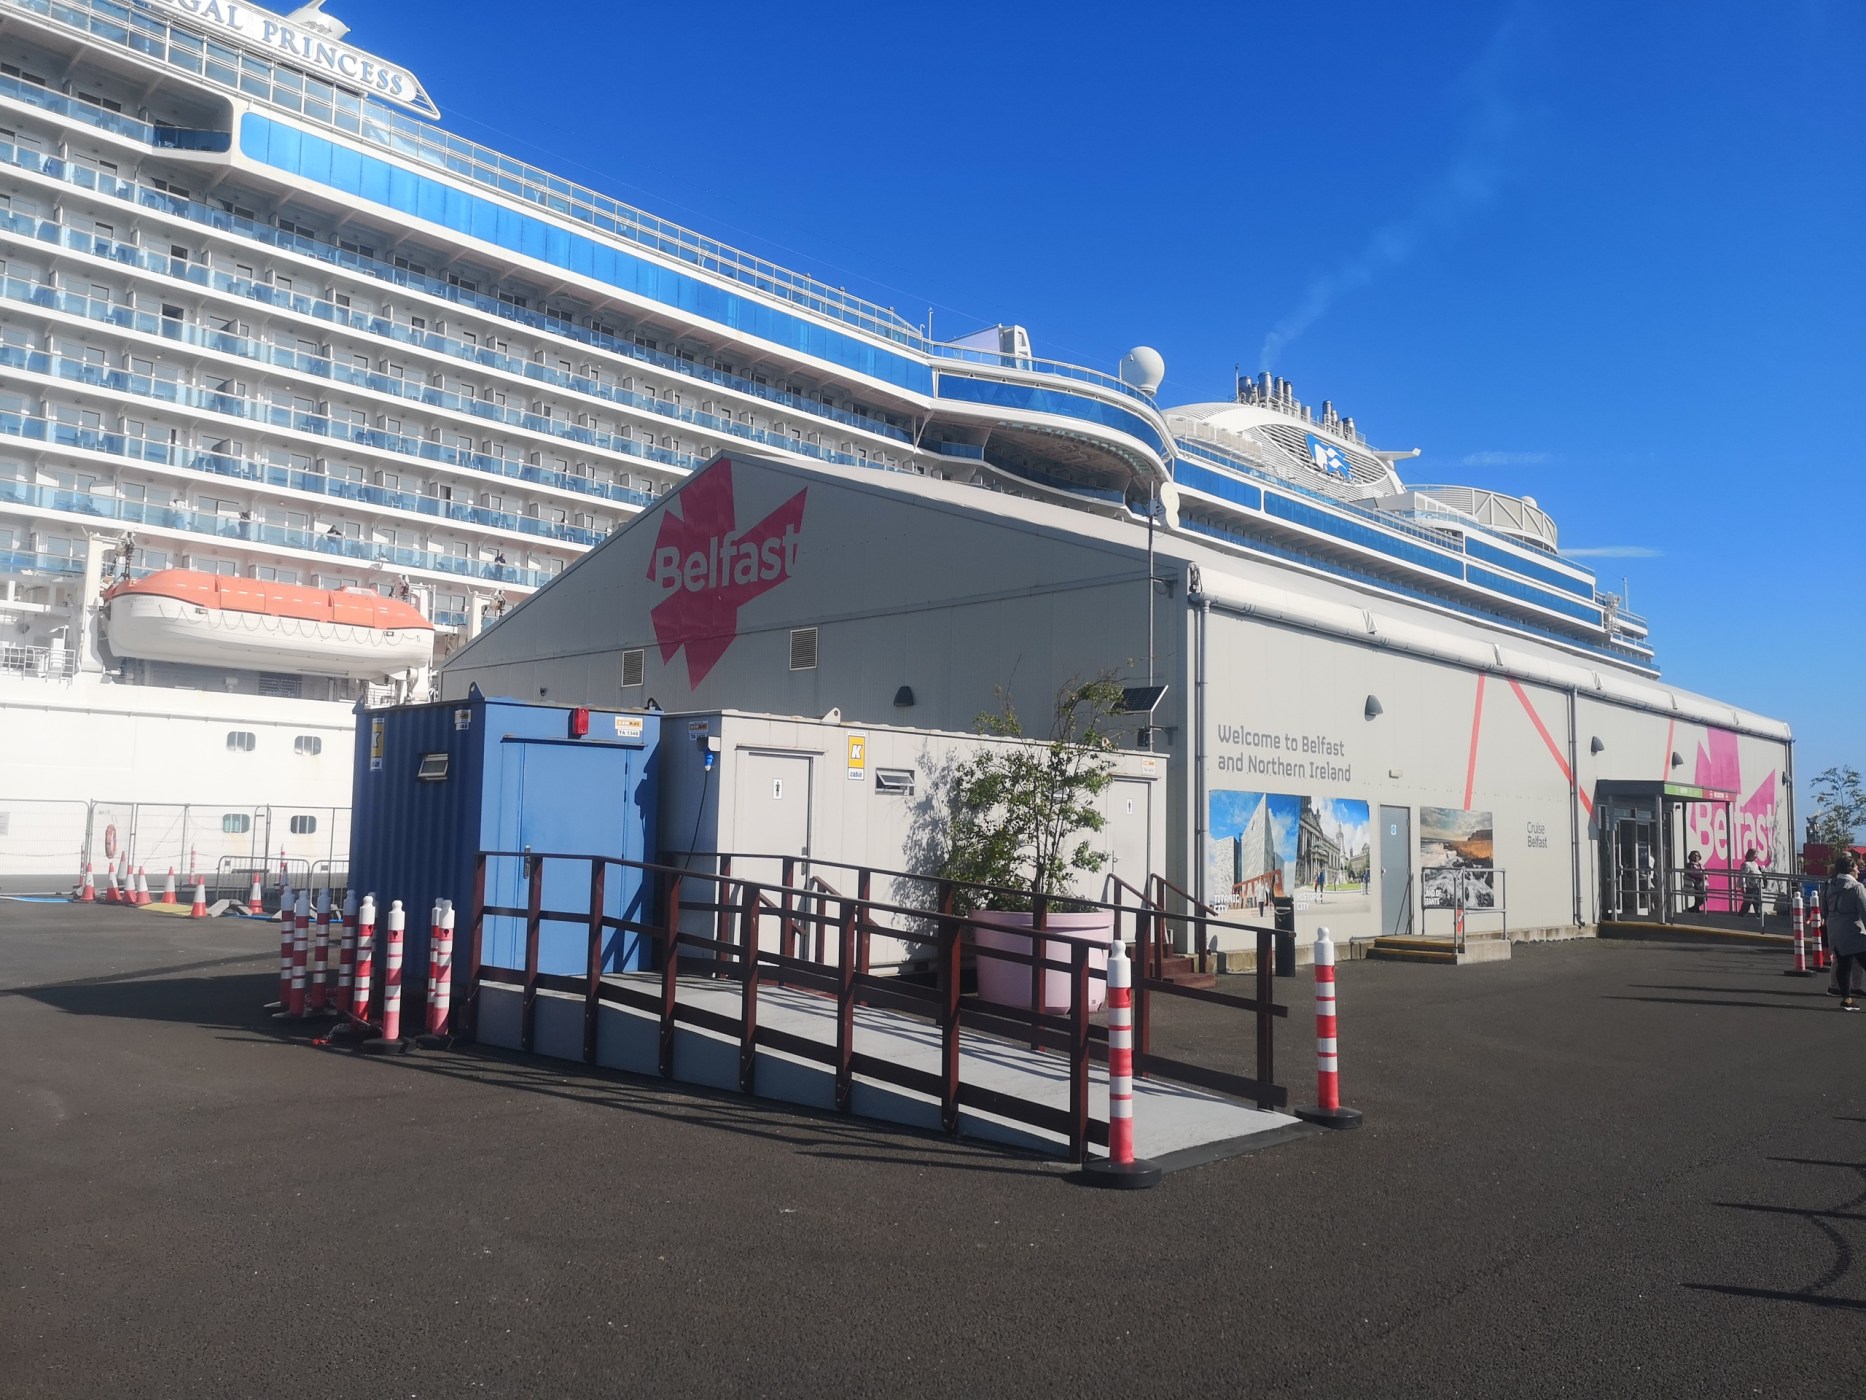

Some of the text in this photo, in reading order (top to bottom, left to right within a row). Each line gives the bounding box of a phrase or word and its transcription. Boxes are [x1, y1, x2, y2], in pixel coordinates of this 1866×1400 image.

[170, 0, 404, 96] GAL PRINCESS
[655, 523, 801, 595] Belfast
[851, 744, 863, 759] K
[1218, 724, 1344, 757] Welcome to Belfast
[1218, 752, 1351, 782] and Northern Ireland
[1527, 820, 1545, 834] Cruise
[1695, 794, 1776, 862] Belfast
[1527, 835, 1548, 848] Belfast
[1214, 893, 1240, 904] TITANIC
[1297, 902, 1310, 911] CITY
